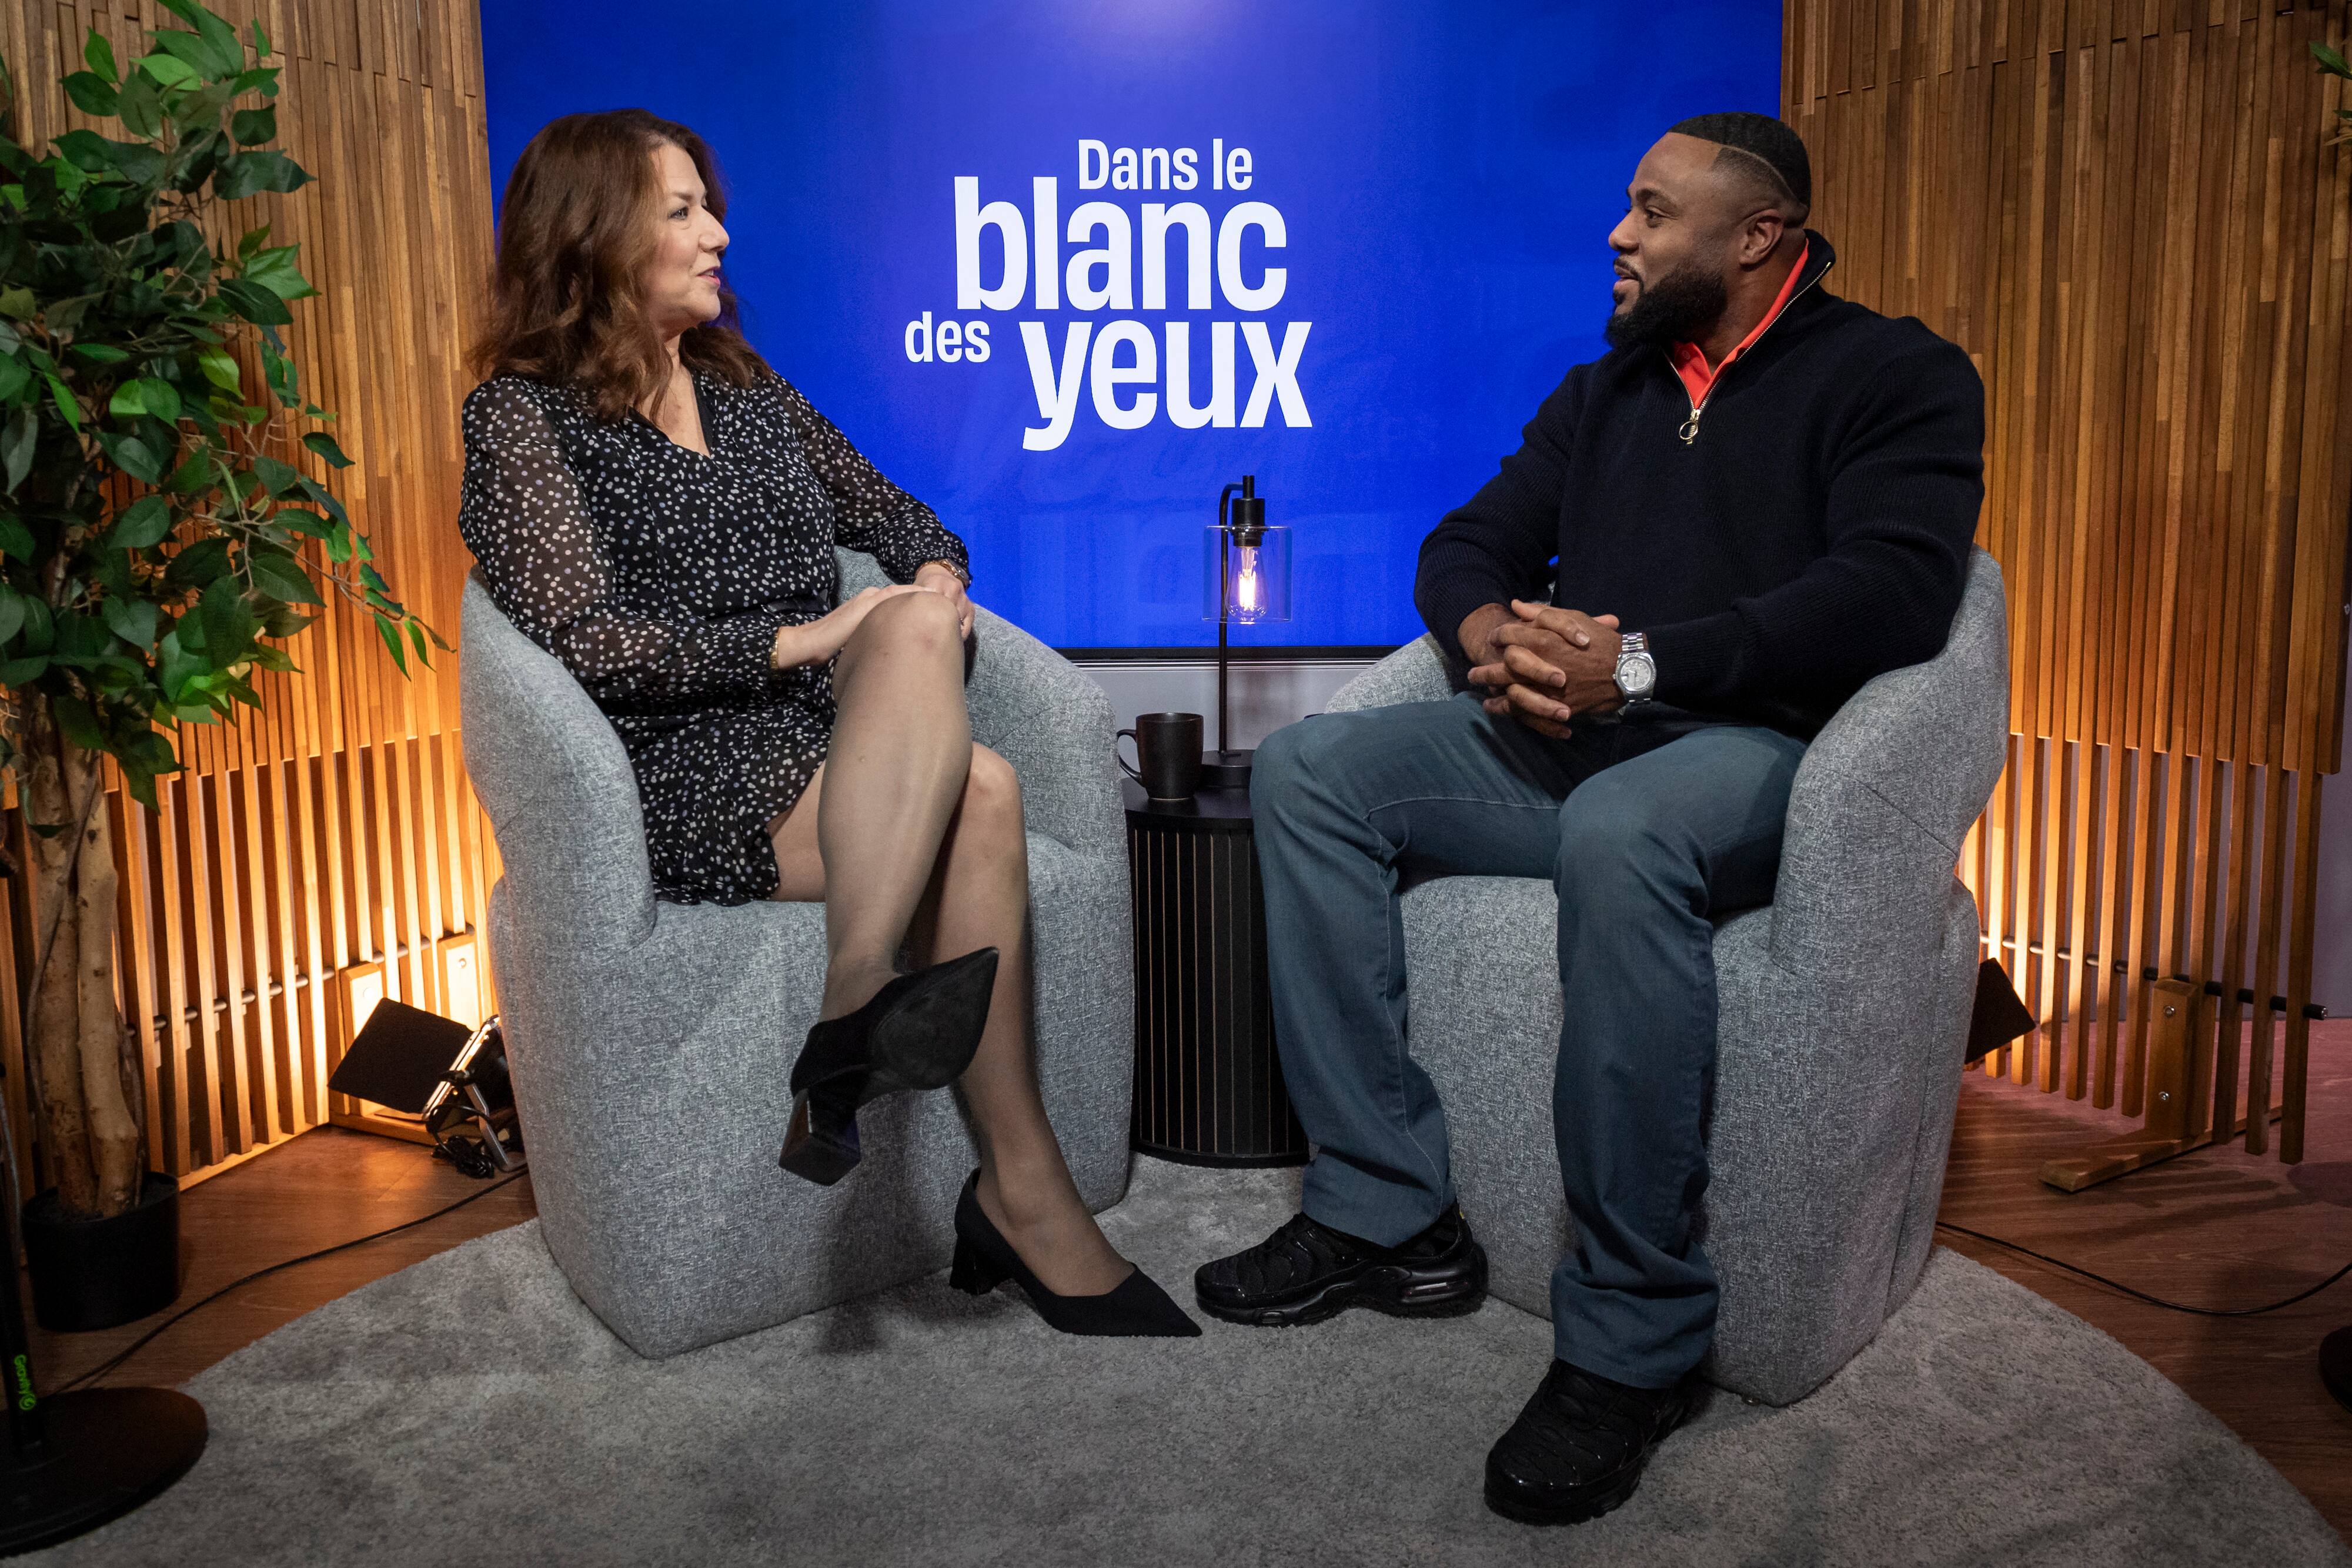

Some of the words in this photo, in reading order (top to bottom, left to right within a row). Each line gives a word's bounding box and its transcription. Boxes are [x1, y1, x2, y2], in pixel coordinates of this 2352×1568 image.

[1079, 139, 1198, 190] Dans
[1212, 139, 1252, 190] le
[954, 176, 1287, 311] blanc
[904, 311, 991, 363] des
[1019, 320, 1313, 452] yeux
